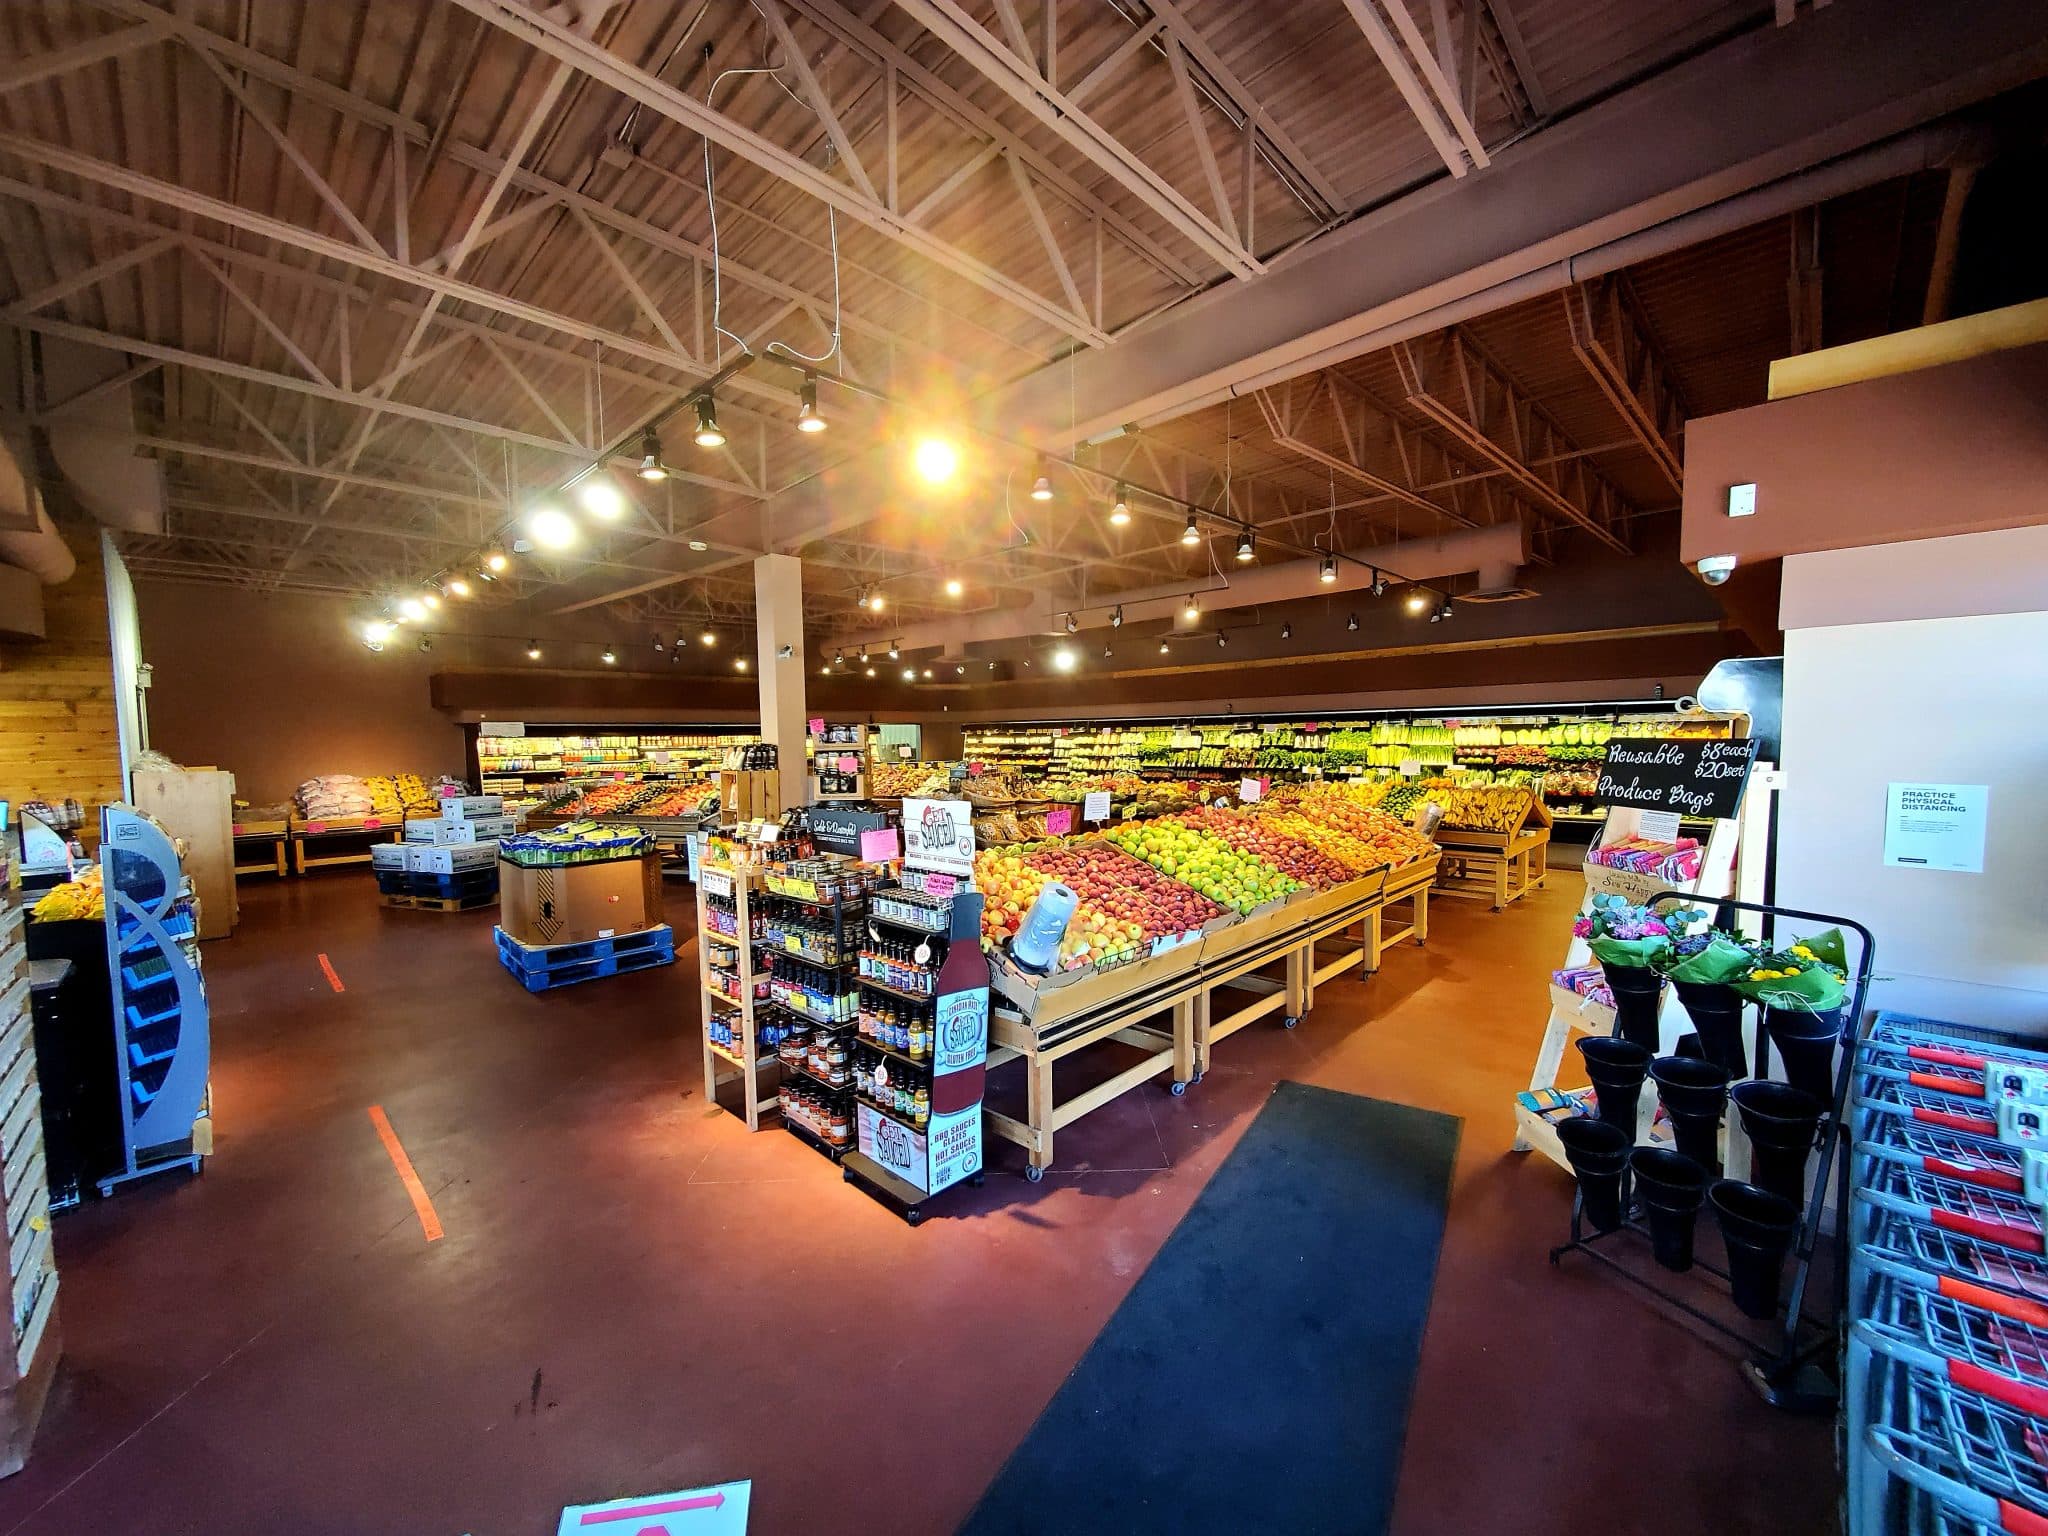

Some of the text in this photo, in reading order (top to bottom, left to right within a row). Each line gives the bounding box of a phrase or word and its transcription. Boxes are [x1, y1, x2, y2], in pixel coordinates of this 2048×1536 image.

[1608, 743, 1685, 766] Reusable
[1598, 775, 1715, 815] Produce Bags
[1901, 798, 1954, 806] PHYSICAL
[1902, 791, 1957, 799] PRACTICE
[923, 805, 946, 827] GET
[1901, 804, 1967, 812] DISTANCING
[920, 812, 956, 850] SAUCED
[934, 1117, 976, 1143] BBQ SAUCES
[943, 1130, 967, 1148] GLAZES
[876, 1130, 911, 1169] SAUCED
[935, 1136, 976, 1162] HOT SAUCES
